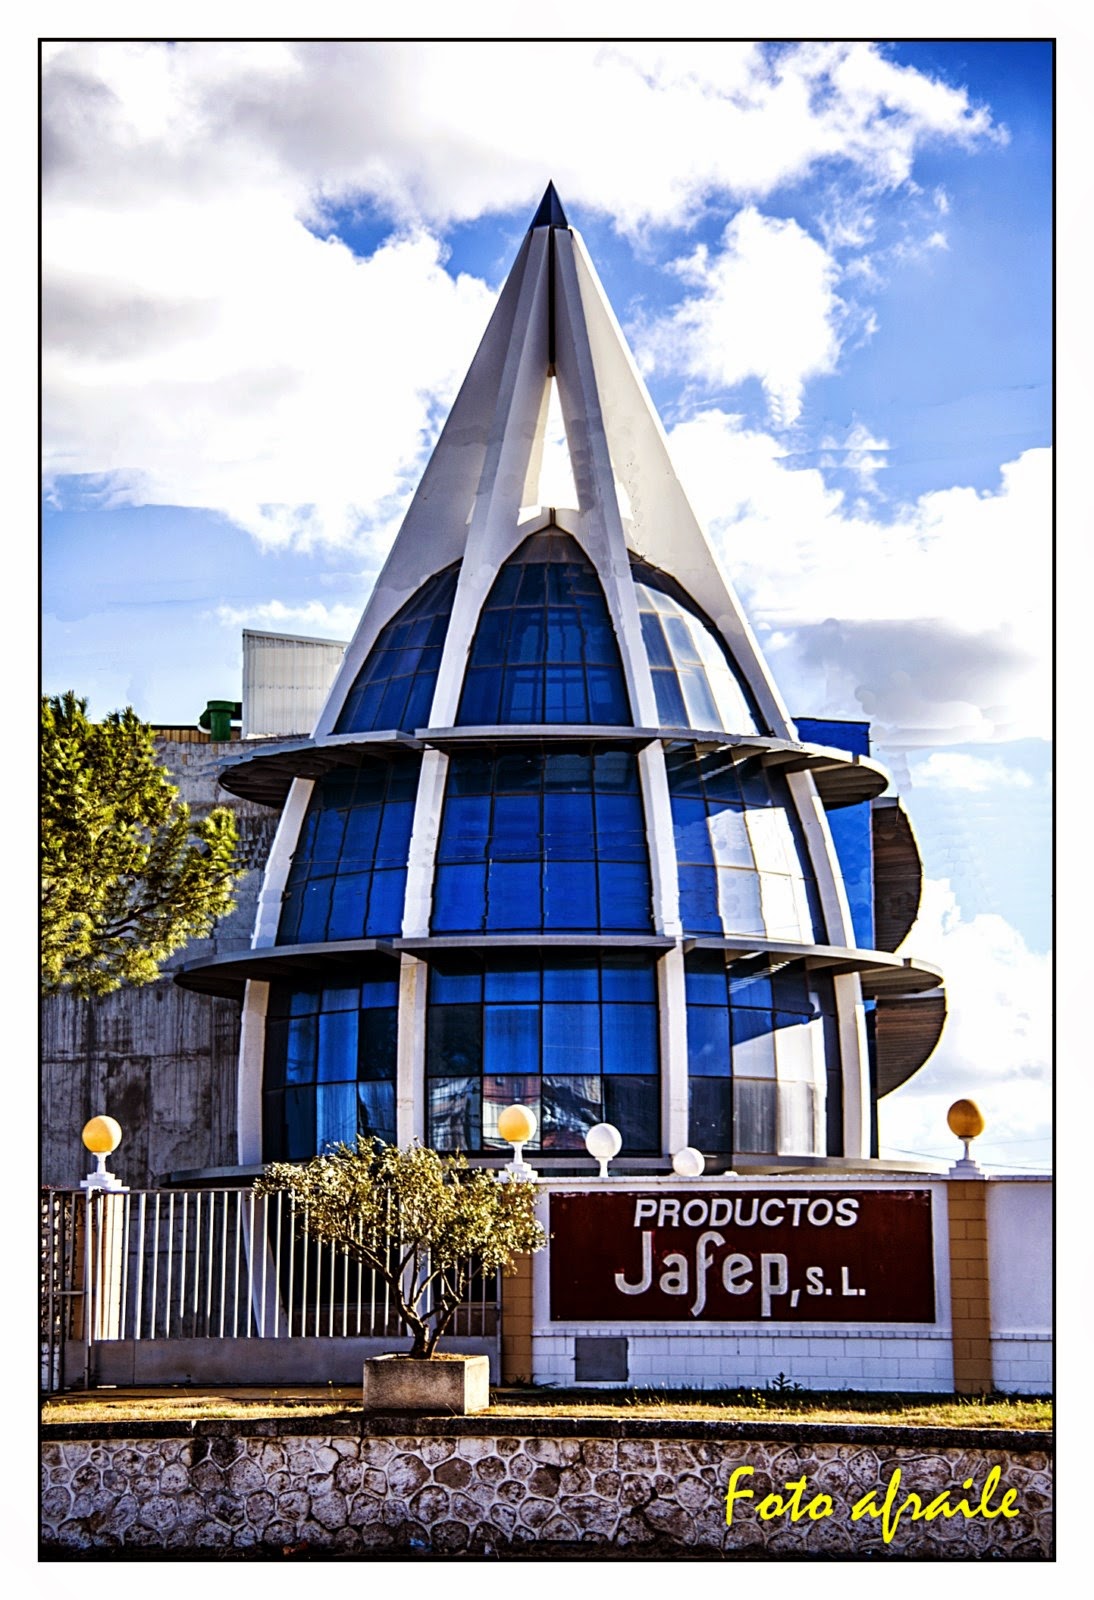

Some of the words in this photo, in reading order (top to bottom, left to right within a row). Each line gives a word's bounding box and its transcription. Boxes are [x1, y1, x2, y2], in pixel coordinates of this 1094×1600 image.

[634, 1198, 860, 1227] PRODUCTOS
[806, 1266, 832, 1296] S.
[841, 1266, 866, 1296] L.
